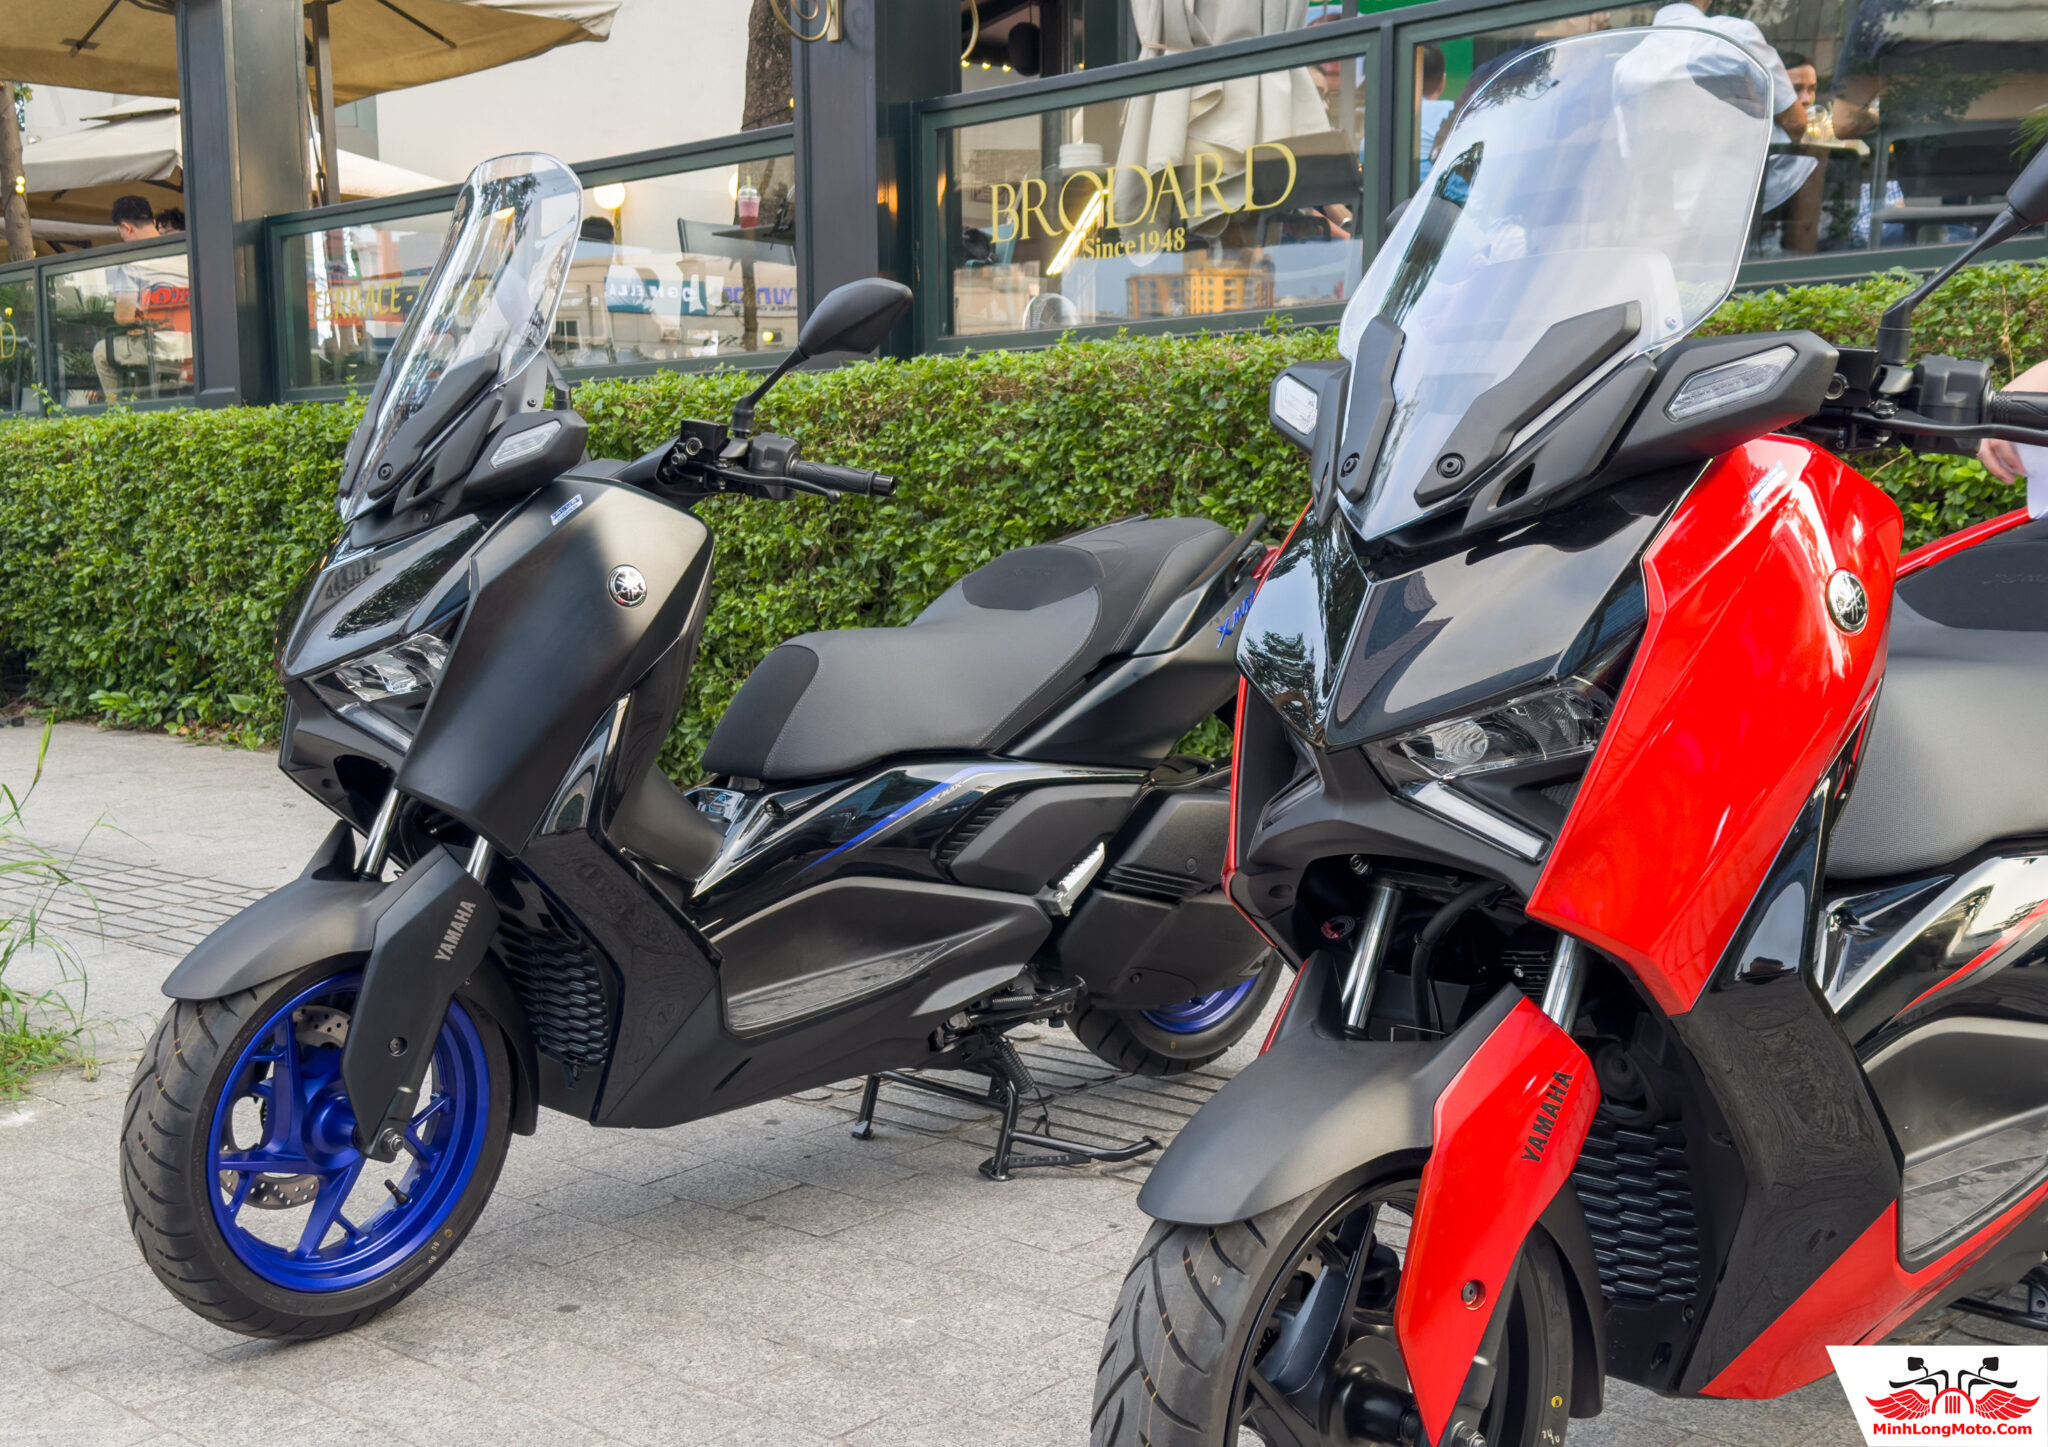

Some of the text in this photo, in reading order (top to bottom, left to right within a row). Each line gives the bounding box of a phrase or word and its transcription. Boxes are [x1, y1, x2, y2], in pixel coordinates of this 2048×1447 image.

[990, 143, 1297, 243] BRODARD
[312, 280, 403, 321] TERRACE
[434, 900, 477, 961] YAMAHA
[1521, 1071, 1573, 1162] YAMAHA
